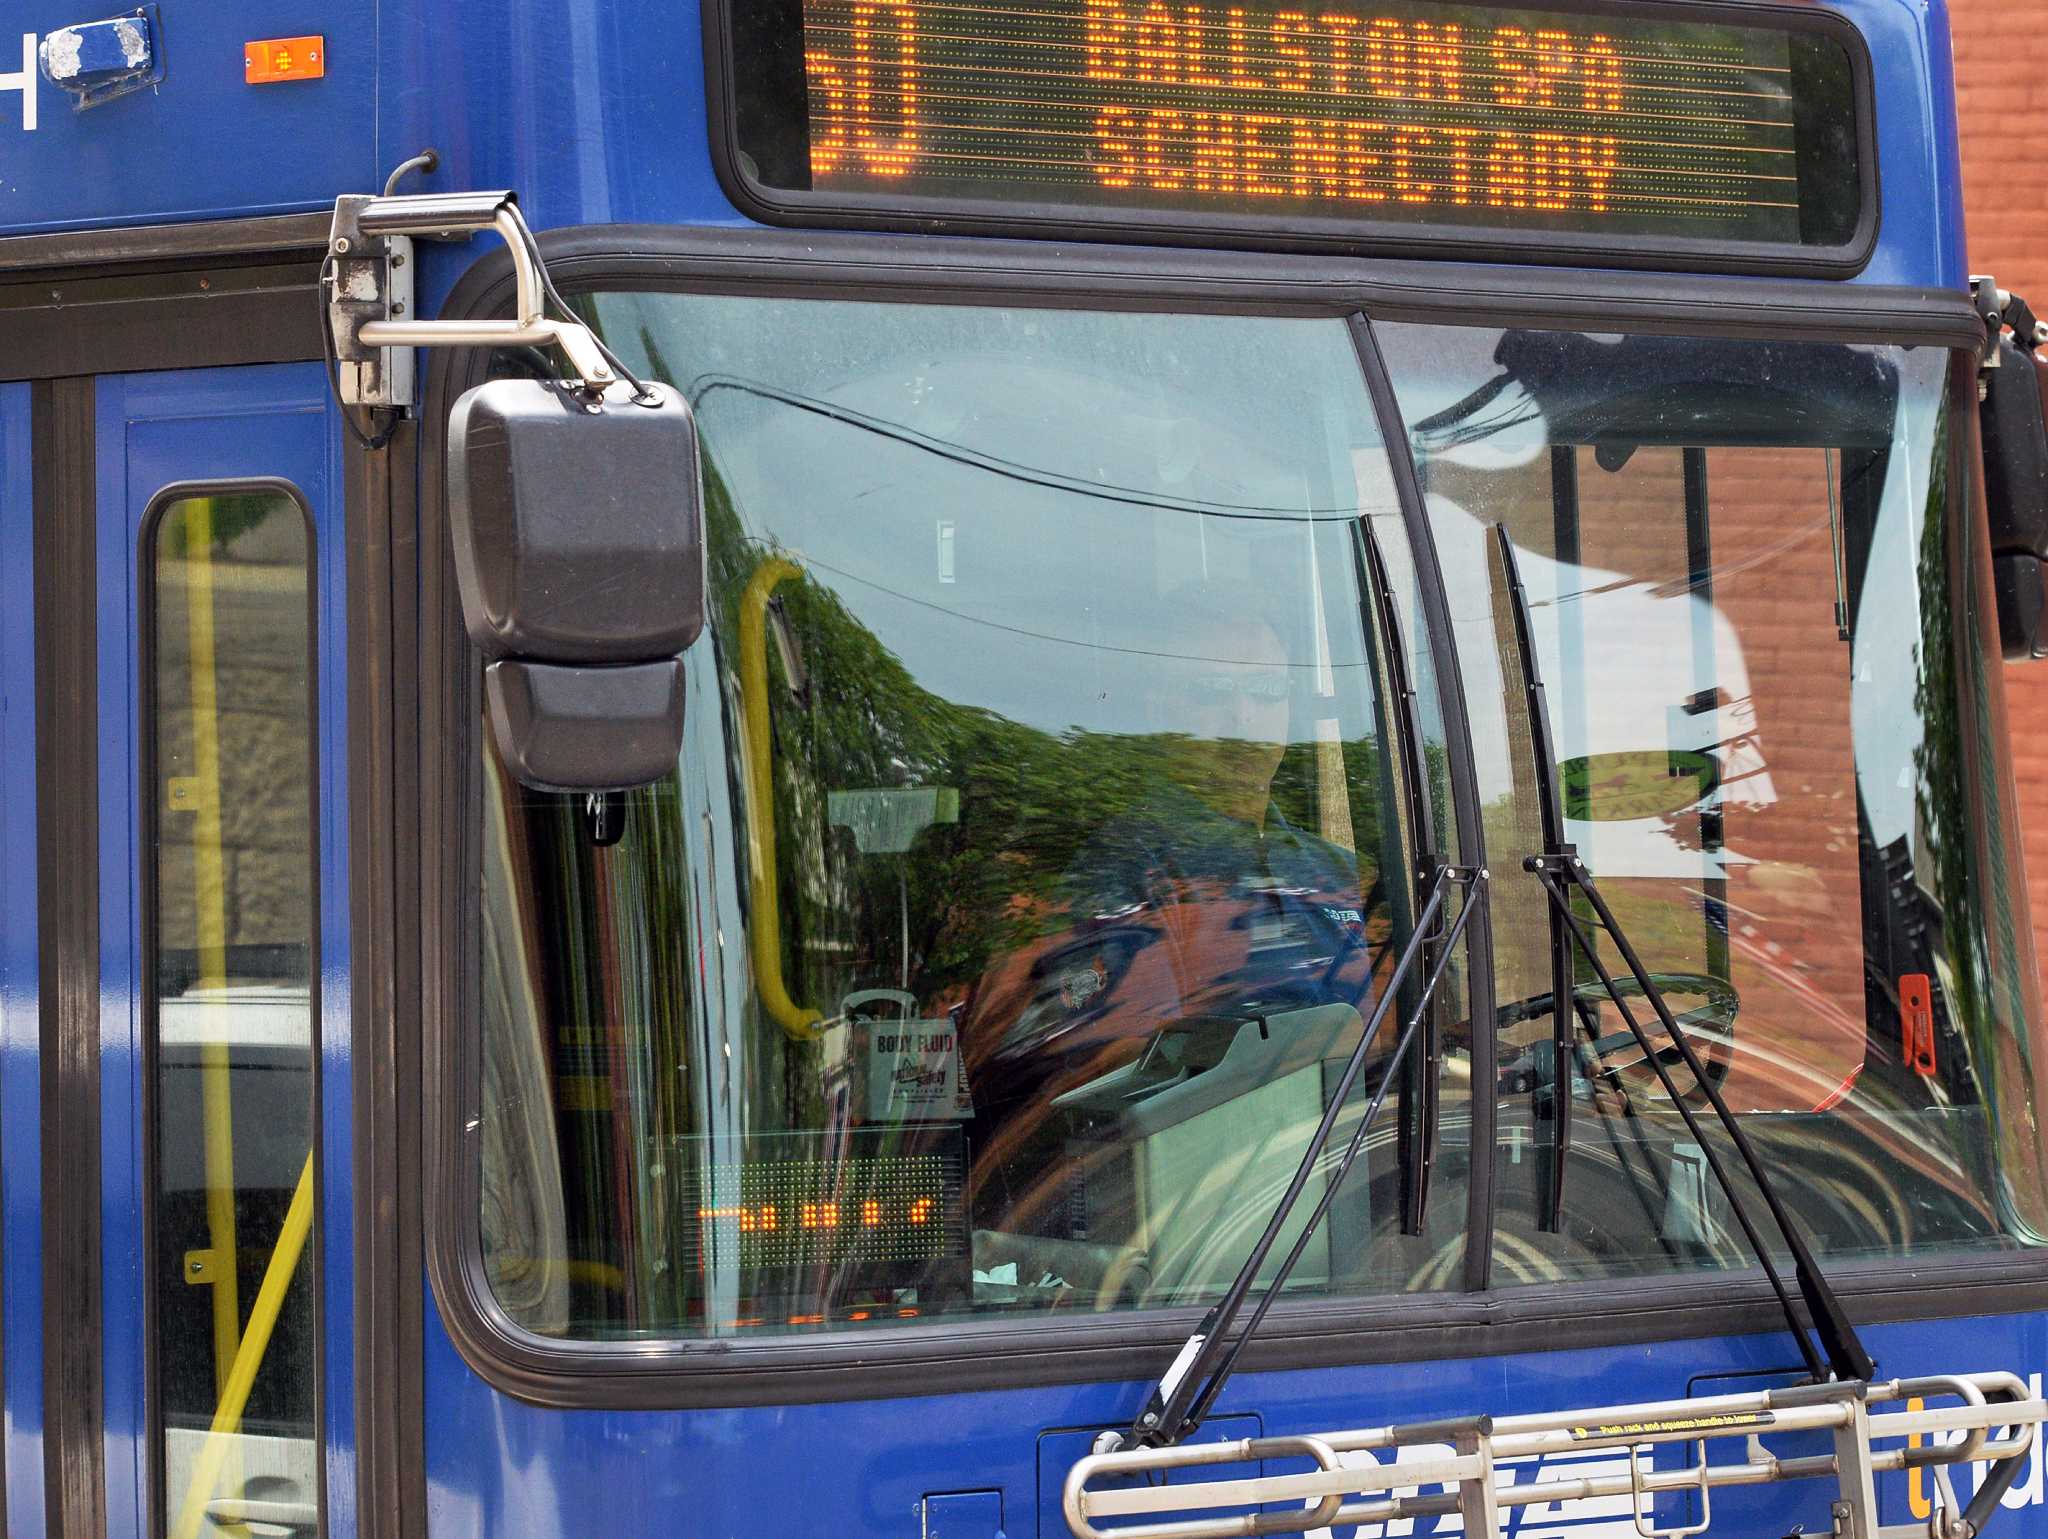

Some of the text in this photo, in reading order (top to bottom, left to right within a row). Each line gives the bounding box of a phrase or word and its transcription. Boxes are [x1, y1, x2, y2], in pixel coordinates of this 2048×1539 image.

[1087, 0, 1620, 112] BALLSTON SPA
[1095, 106, 1618, 213] SCHENECTADY
[1599, 1424, 1624, 1435] Push
[1624, 1423, 1643, 1433] rack
[1644, 1421, 1660, 1432] and
